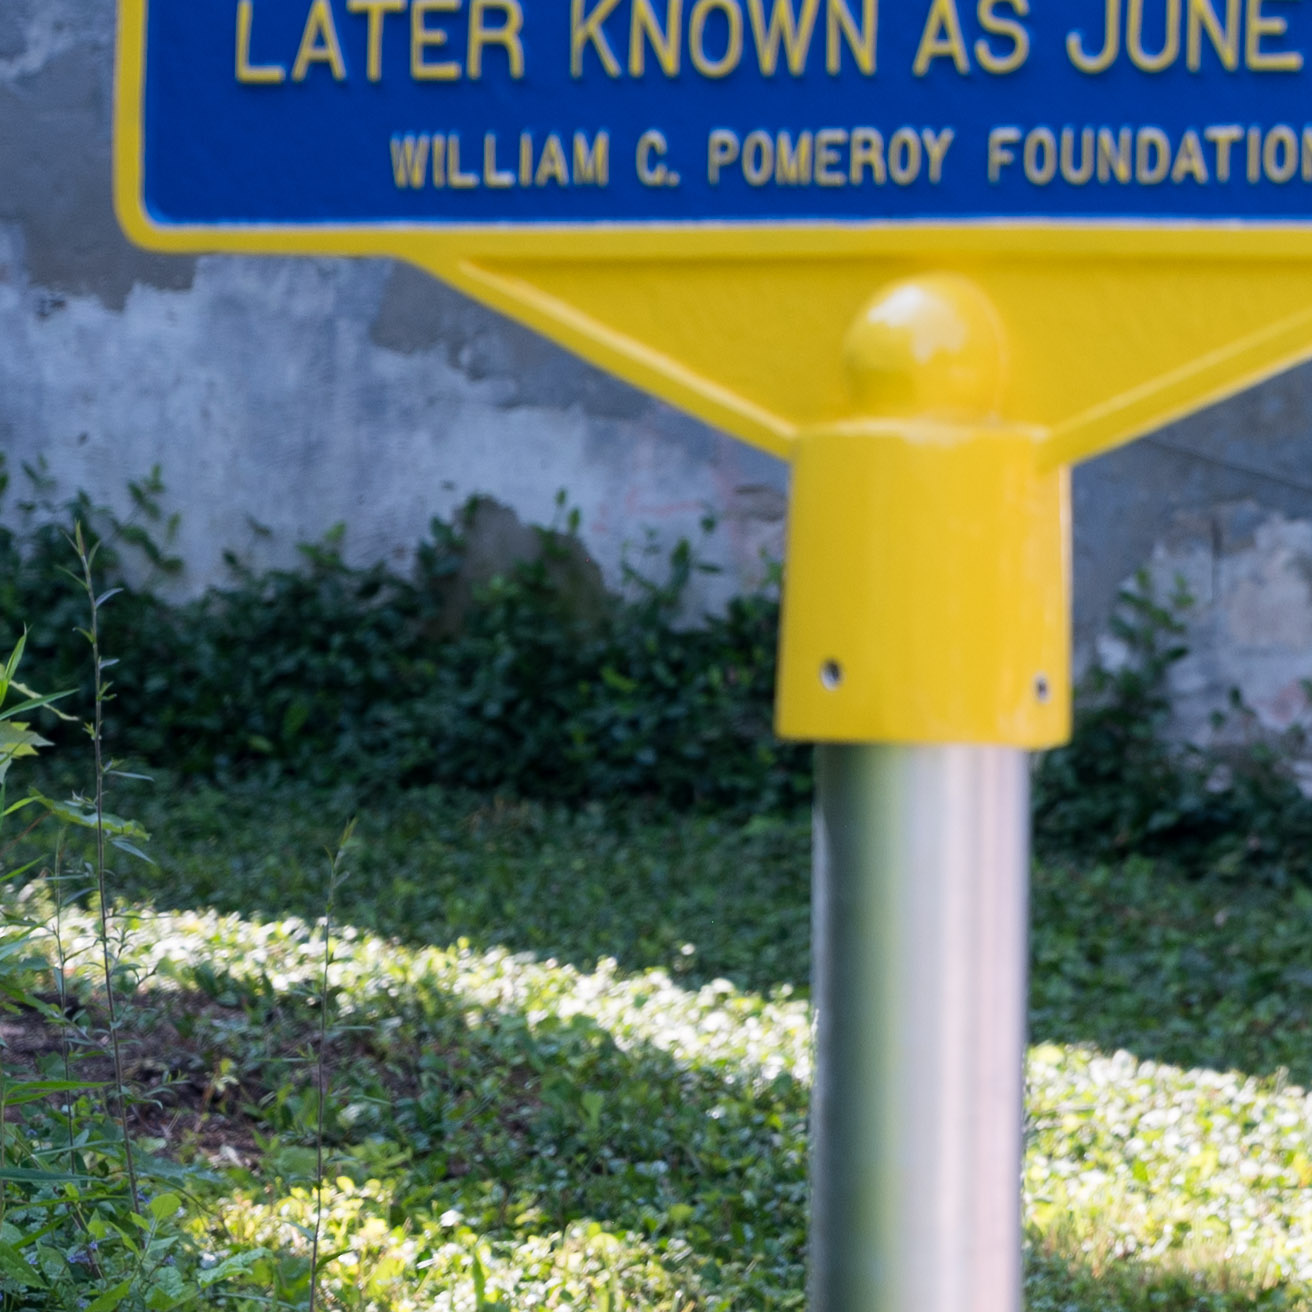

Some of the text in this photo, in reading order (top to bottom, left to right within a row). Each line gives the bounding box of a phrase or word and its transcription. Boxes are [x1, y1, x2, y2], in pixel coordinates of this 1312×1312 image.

[390, 130, 610, 189] WILLIAM
[635, 128, 680, 186] C.
[707, 125, 955, 186] POMEROY
